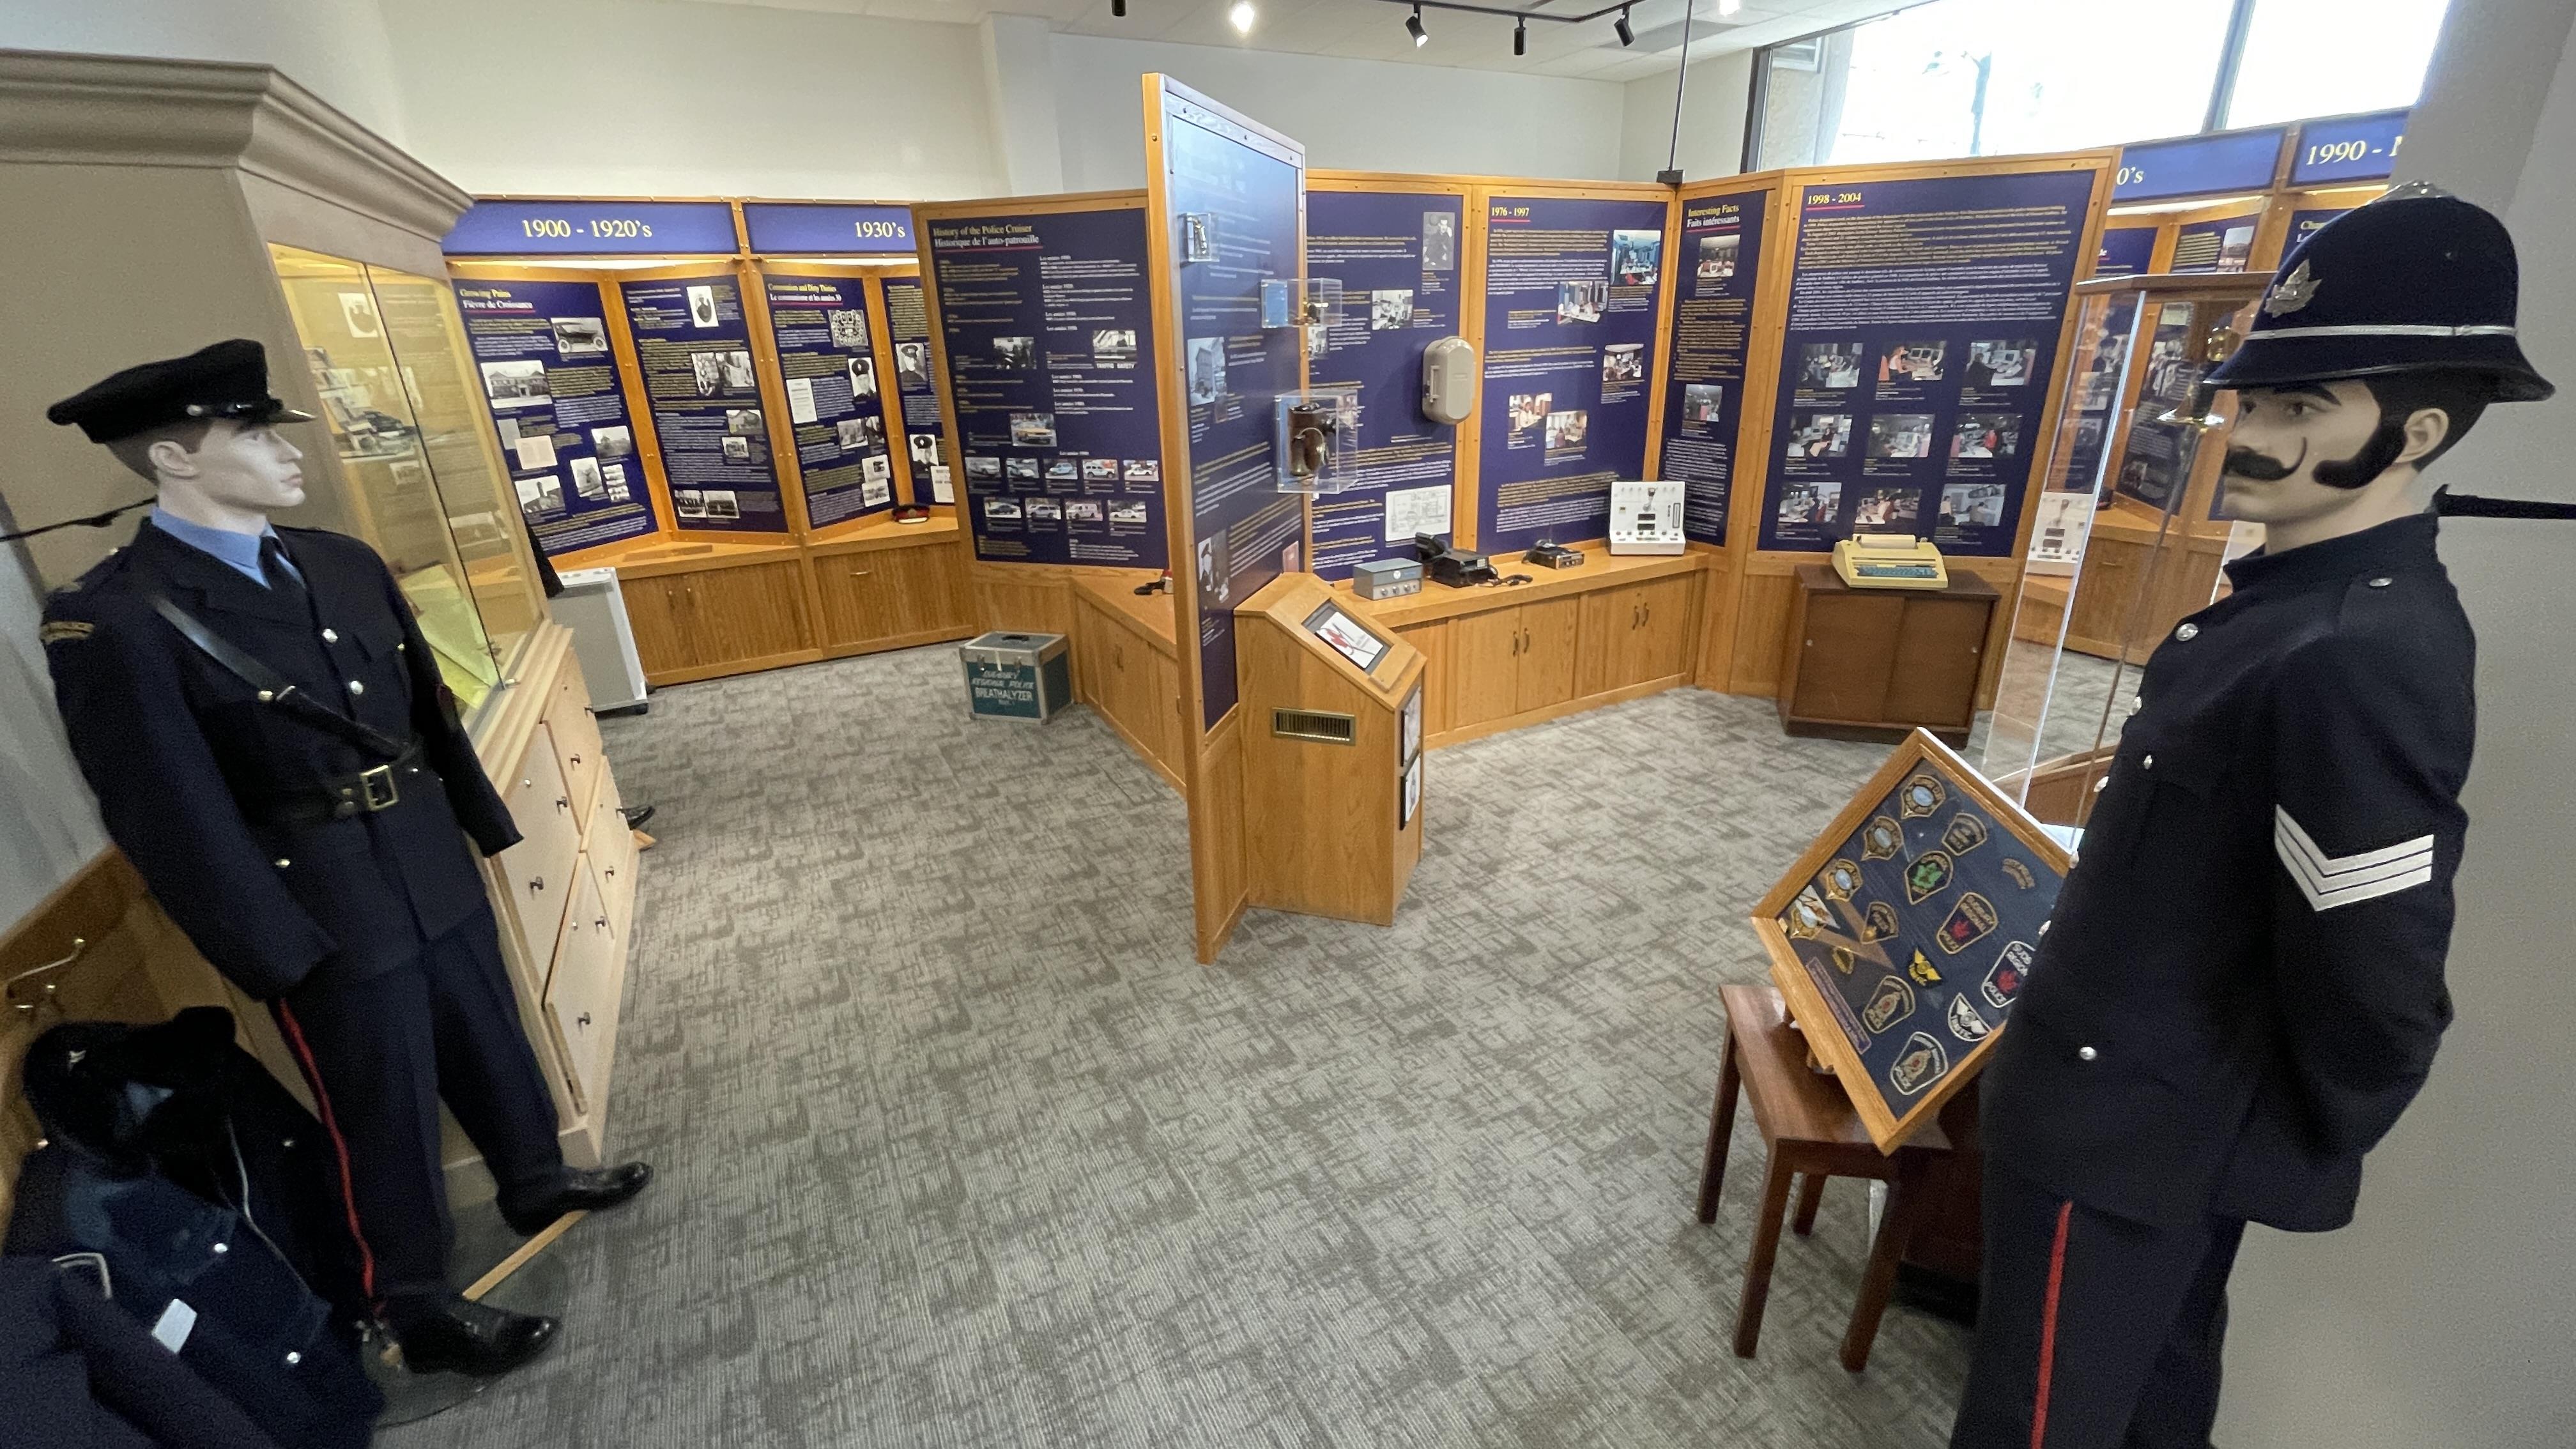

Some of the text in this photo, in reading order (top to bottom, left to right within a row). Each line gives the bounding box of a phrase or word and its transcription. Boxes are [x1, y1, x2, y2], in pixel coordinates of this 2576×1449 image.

[2306, 140, 2367, 165] 1990
[2117, 166, 2144, 185] 0's
[1807, 194, 1830, 204] 1998
[1838, 192, 1862, 203] 2004
[1492, 206, 1508, 217] 1976
[1514, 207, 1529, 217] 1997
[522, 219, 571, 238] 1900
[590, 219, 653, 238] 1920's
[855, 221, 906, 238] 1930's
[975, 686, 1034, 702] BREATHALYZER
